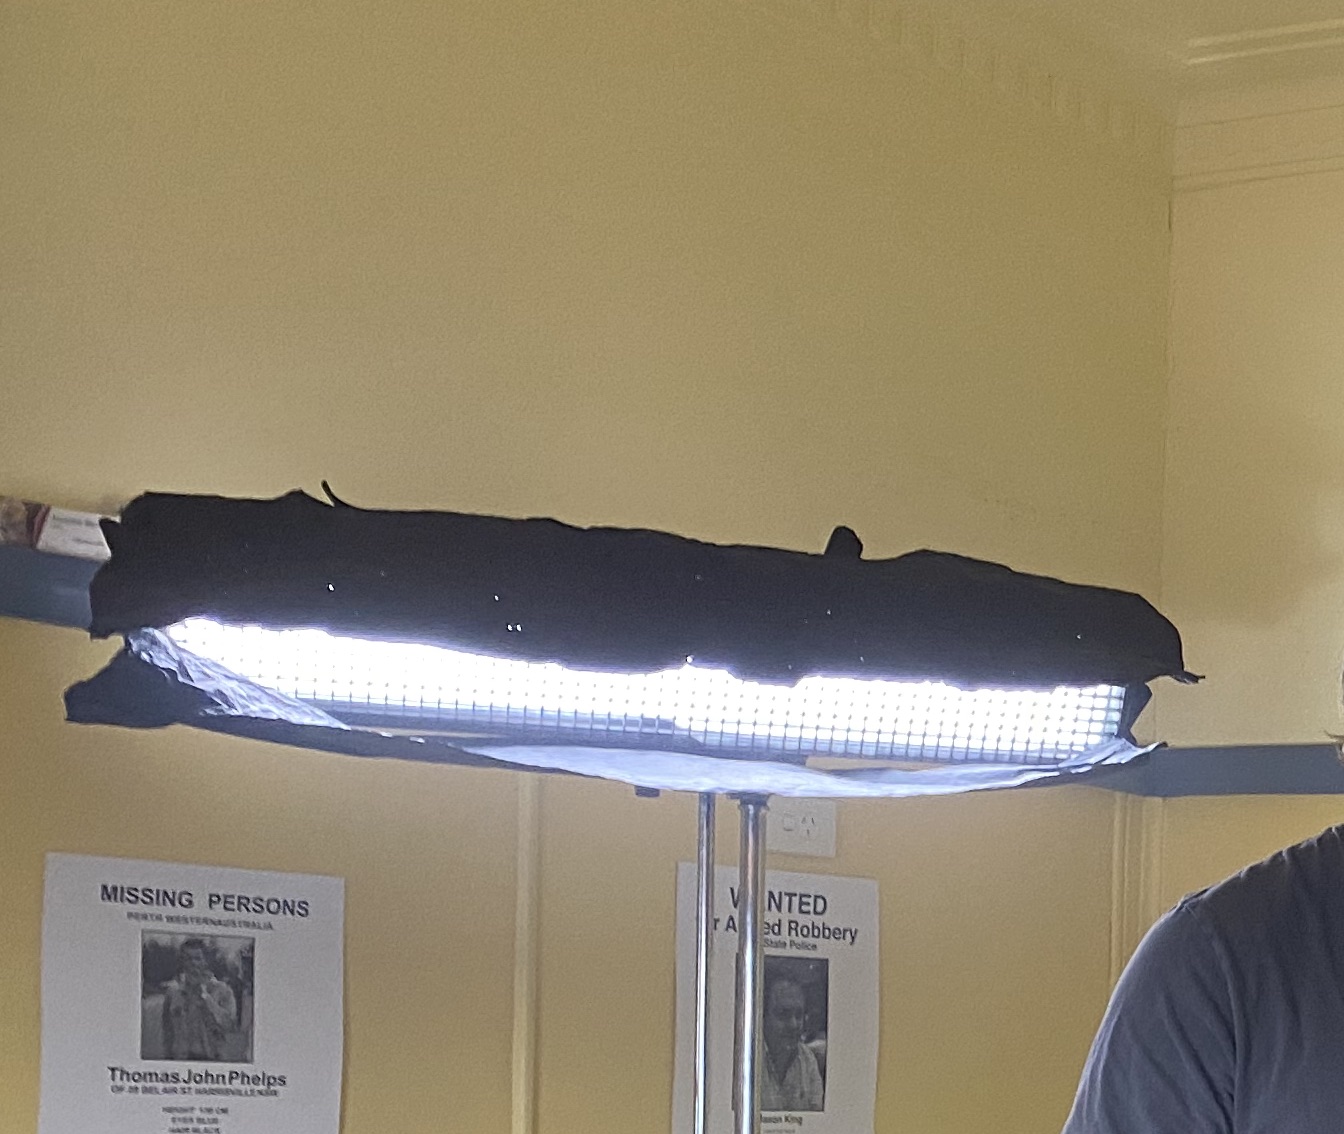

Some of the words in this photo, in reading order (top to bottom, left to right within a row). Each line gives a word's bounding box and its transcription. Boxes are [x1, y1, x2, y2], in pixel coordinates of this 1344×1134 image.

[100, 884, 194, 909] MISSING
[208, 893, 310, 918] PERSONS
[729, 887, 828, 916] NTED
[724, 914, 782, 937] Aed
[787, 919, 859, 946] Robbery
[789, 939, 818, 951] Police
[108, 1066, 182, 1084] Thomas
[182, 1069, 226, 1085] John
[228, 1070, 287, 1089] Phelps
[784, 1114, 803, 1126] King
